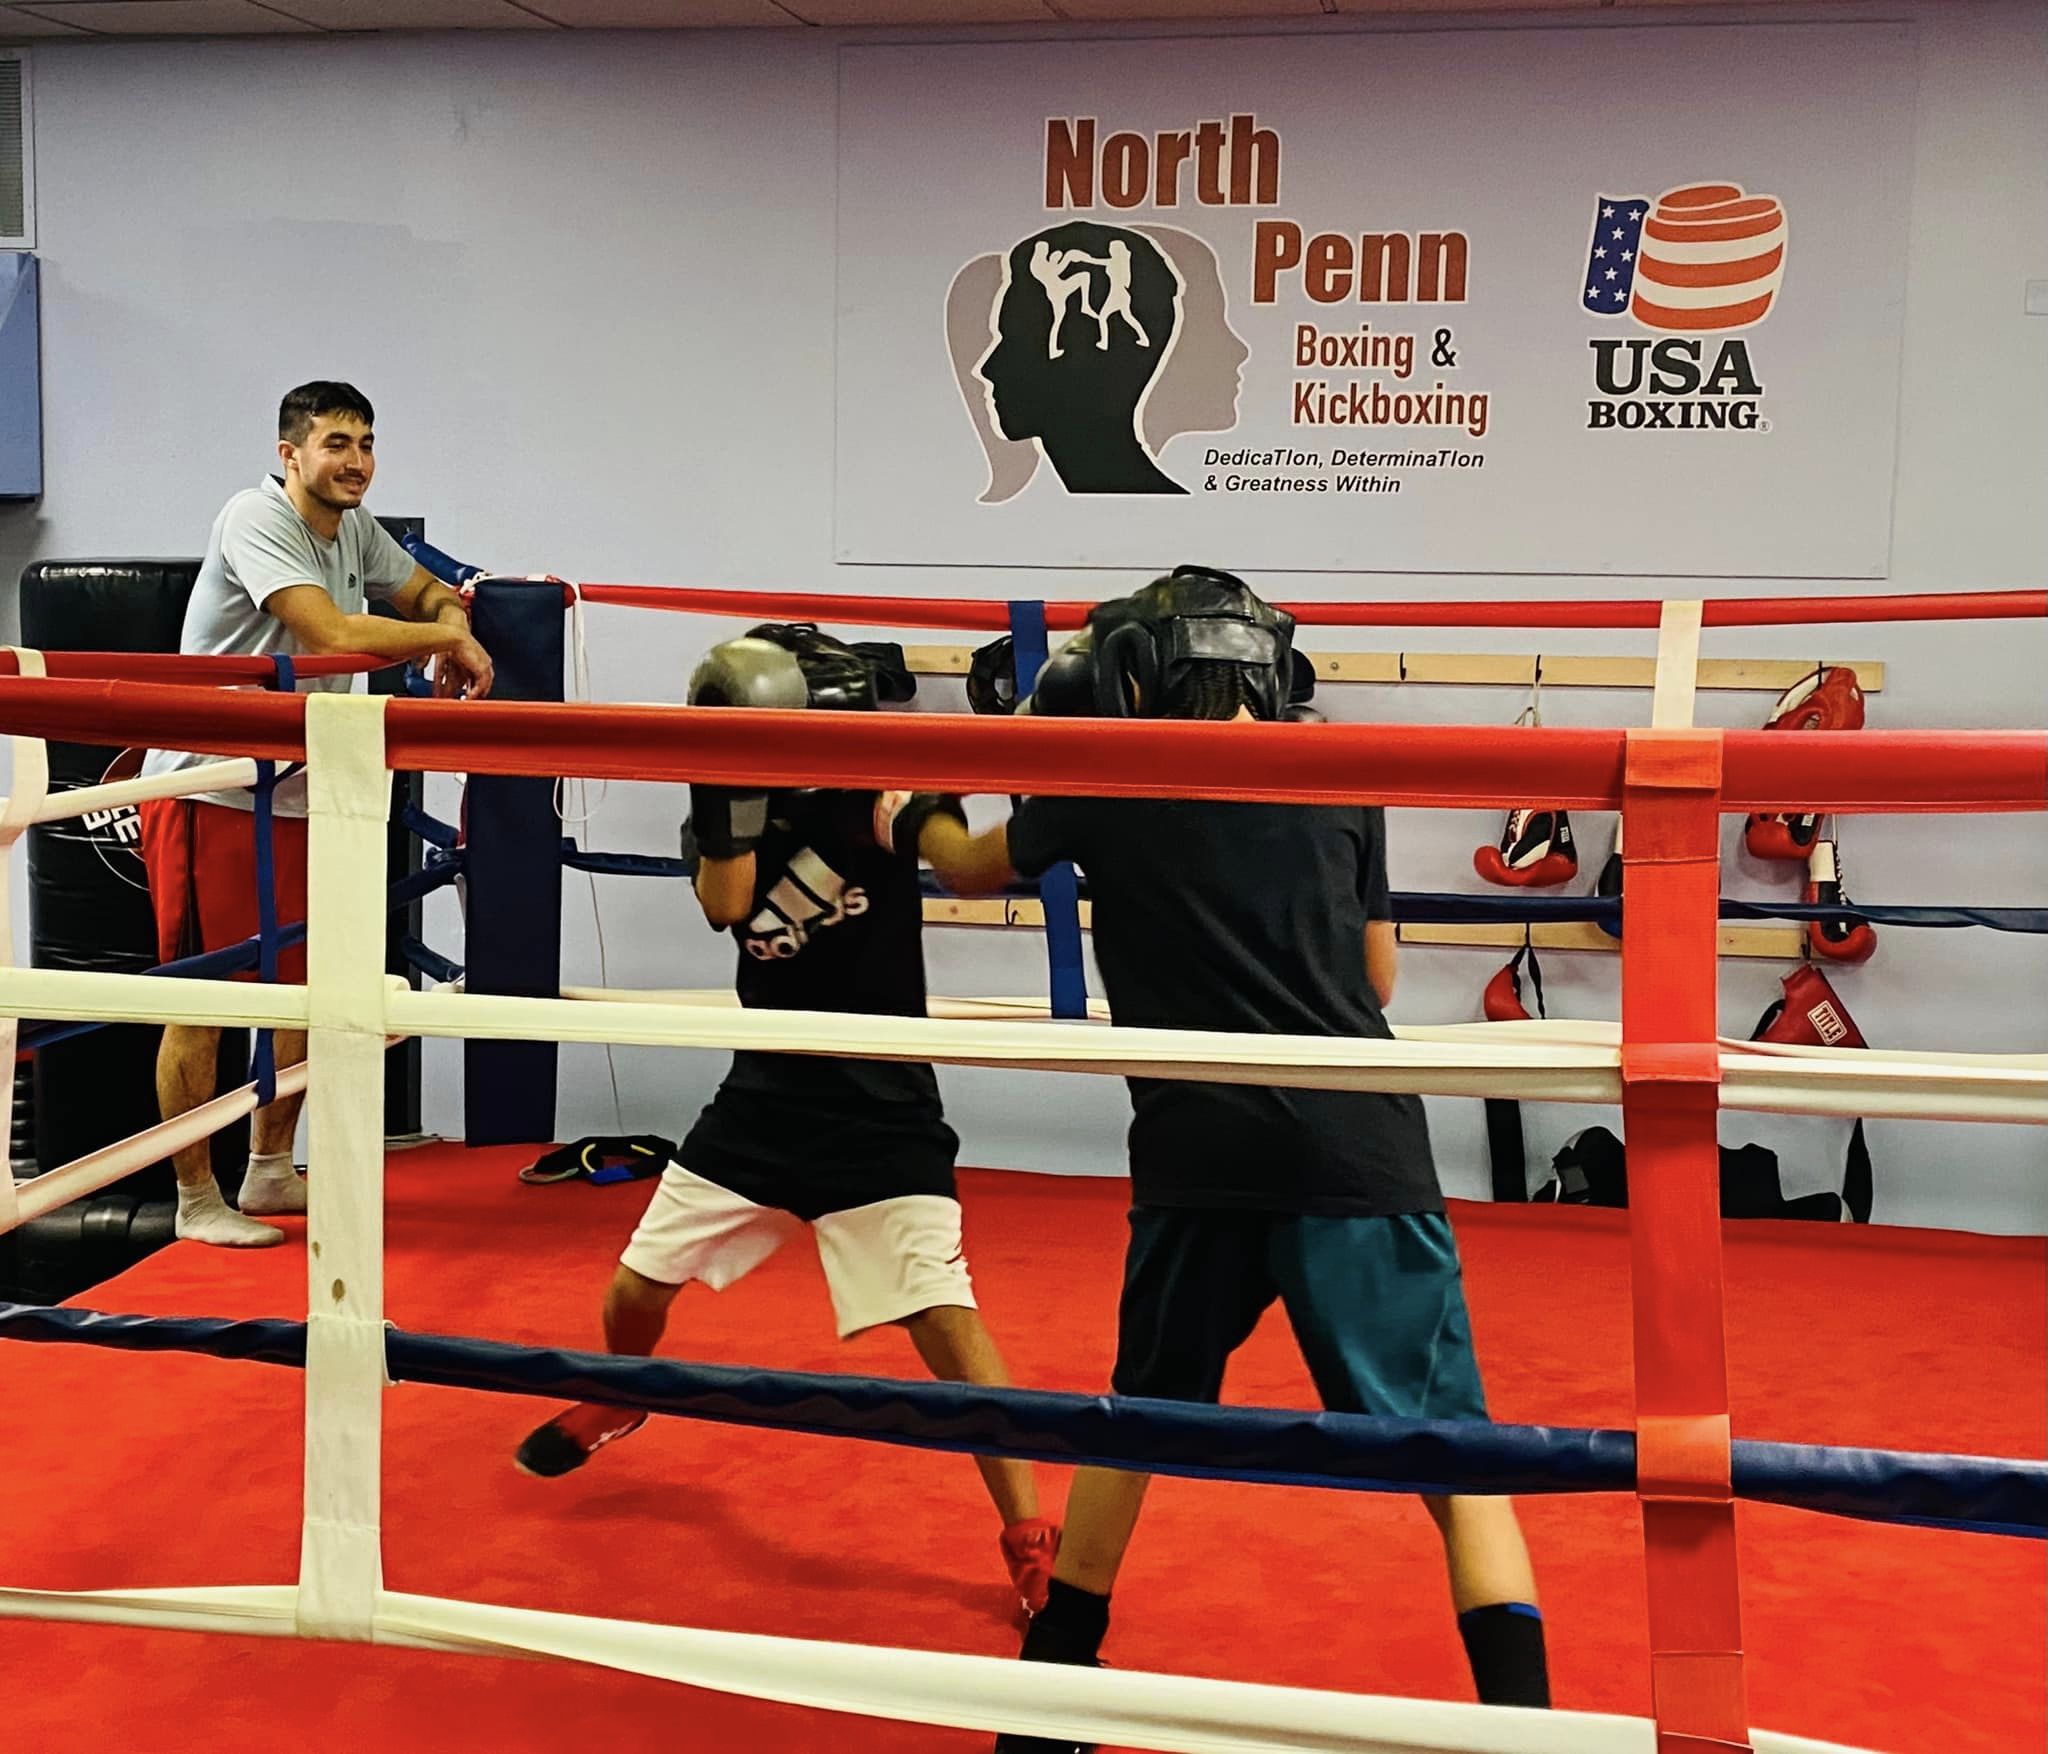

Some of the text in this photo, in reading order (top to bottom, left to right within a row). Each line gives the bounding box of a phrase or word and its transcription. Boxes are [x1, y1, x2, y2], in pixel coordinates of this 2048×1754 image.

[1045, 115, 1279, 207] North
[1253, 220, 1468, 302] Penn
[1296, 325, 1457, 376] Boxing &
[1589, 338, 1762, 395] USA
[1293, 383, 1488, 435] Kickboxing
[1587, 401, 1759, 428] BOXING
[1204, 475, 1401, 493] & Greatness Within
[1812, 1004, 1843, 1041] TITLE
